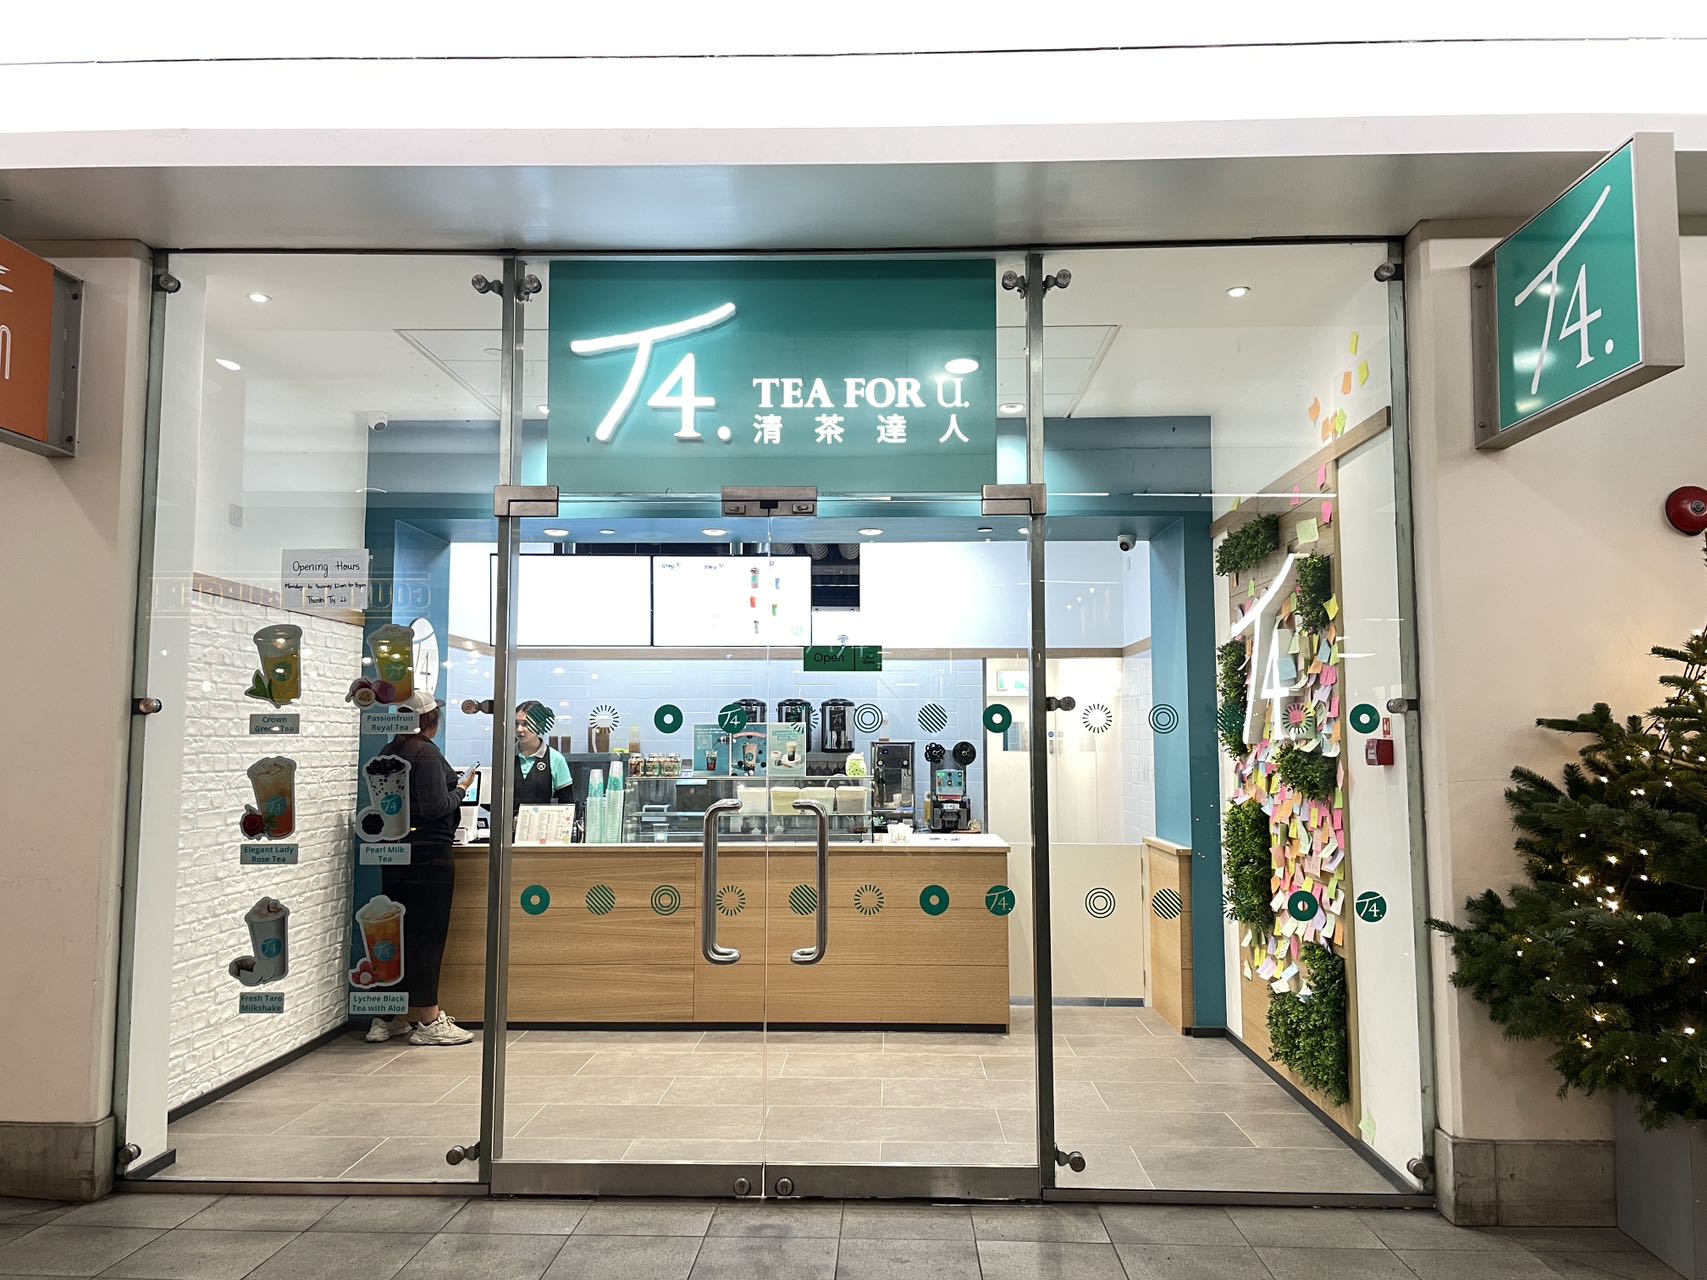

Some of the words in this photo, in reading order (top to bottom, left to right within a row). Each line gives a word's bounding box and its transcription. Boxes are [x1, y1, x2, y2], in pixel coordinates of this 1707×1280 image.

[752, 377, 833, 408] TEA
[843, 377, 926, 408] FOR
[752, 413, 970, 445] 清茶達人
[292, 560, 329, 578] Opening
[334, 560, 361, 571] Hours
[813, 652, 845, 664] Open
[366, 714, 414, 722] Passionfruit
[371, 724, 393, 733] Royal
[244, 846, 274, 855] Elegant
[275, 846, 294, 855] Lady
[365, 846, 386, 854] Pearl
[387, 846, 405, 854] Milk
[251, 855, 271, 863] Rose
[272, 855, 286, 863] Tea
[378, 855, 393, 863] Tea
[241, 994, 263, 1002] Fresh
[264, 994, 283, 1002] Taro
[353, 994, 381, 1003] Lychee
[383, 994, 405, 1002] Black
[241, 1004, 282, 1012] Milkshake
[352, 1004, 366, 1012] Tea
[368, 1004, 387, 1012] with
[388, 1004, 406, 1012] Aloe
